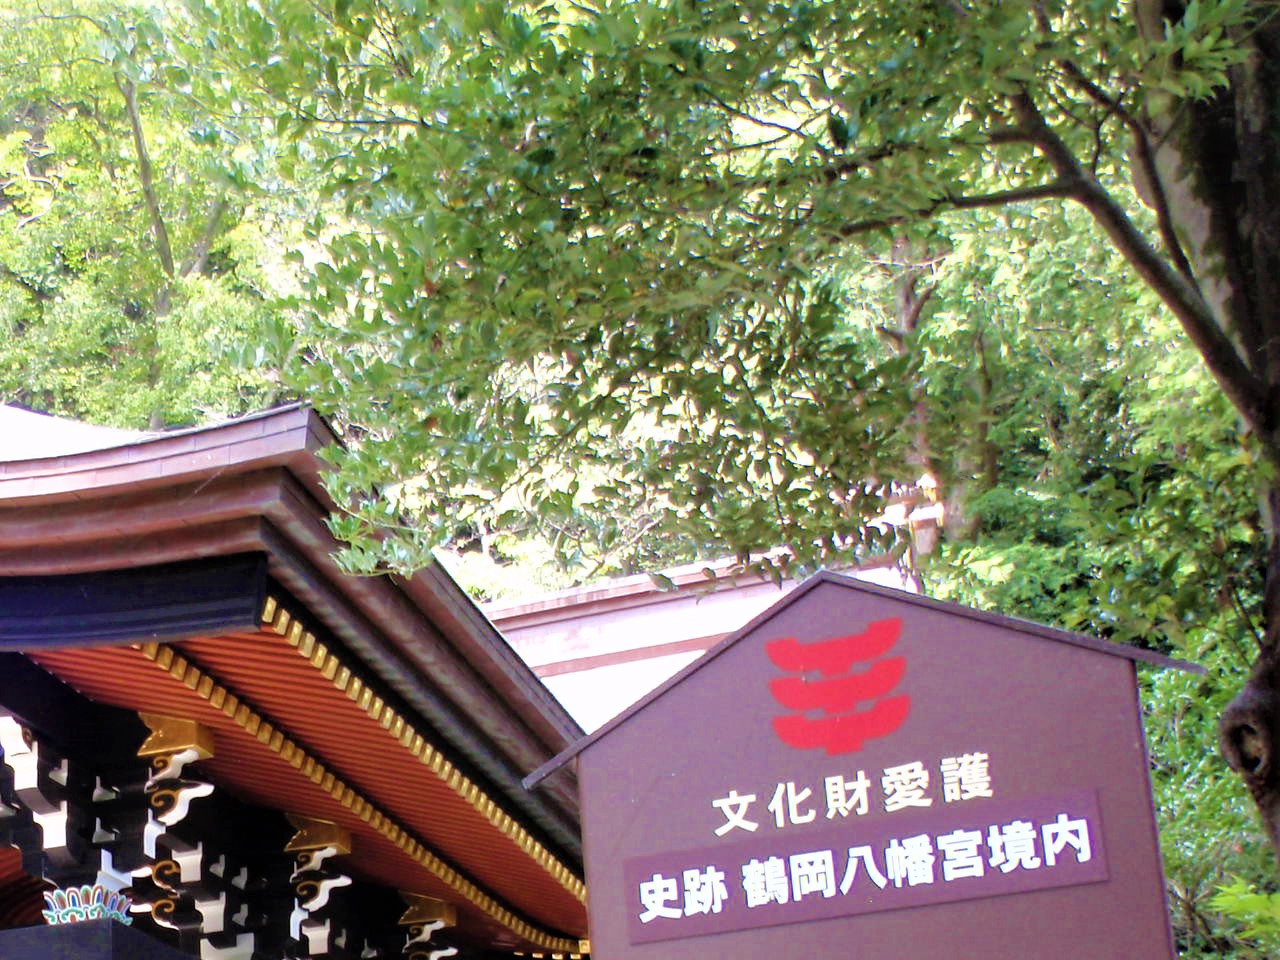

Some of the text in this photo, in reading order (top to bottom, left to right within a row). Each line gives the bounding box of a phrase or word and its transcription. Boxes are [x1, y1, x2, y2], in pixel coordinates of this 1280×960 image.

[712, 752, 994, 837] 文化財愛護
[639, 813, 1091, 924] 史跡 鶴岡八幡宮境内
